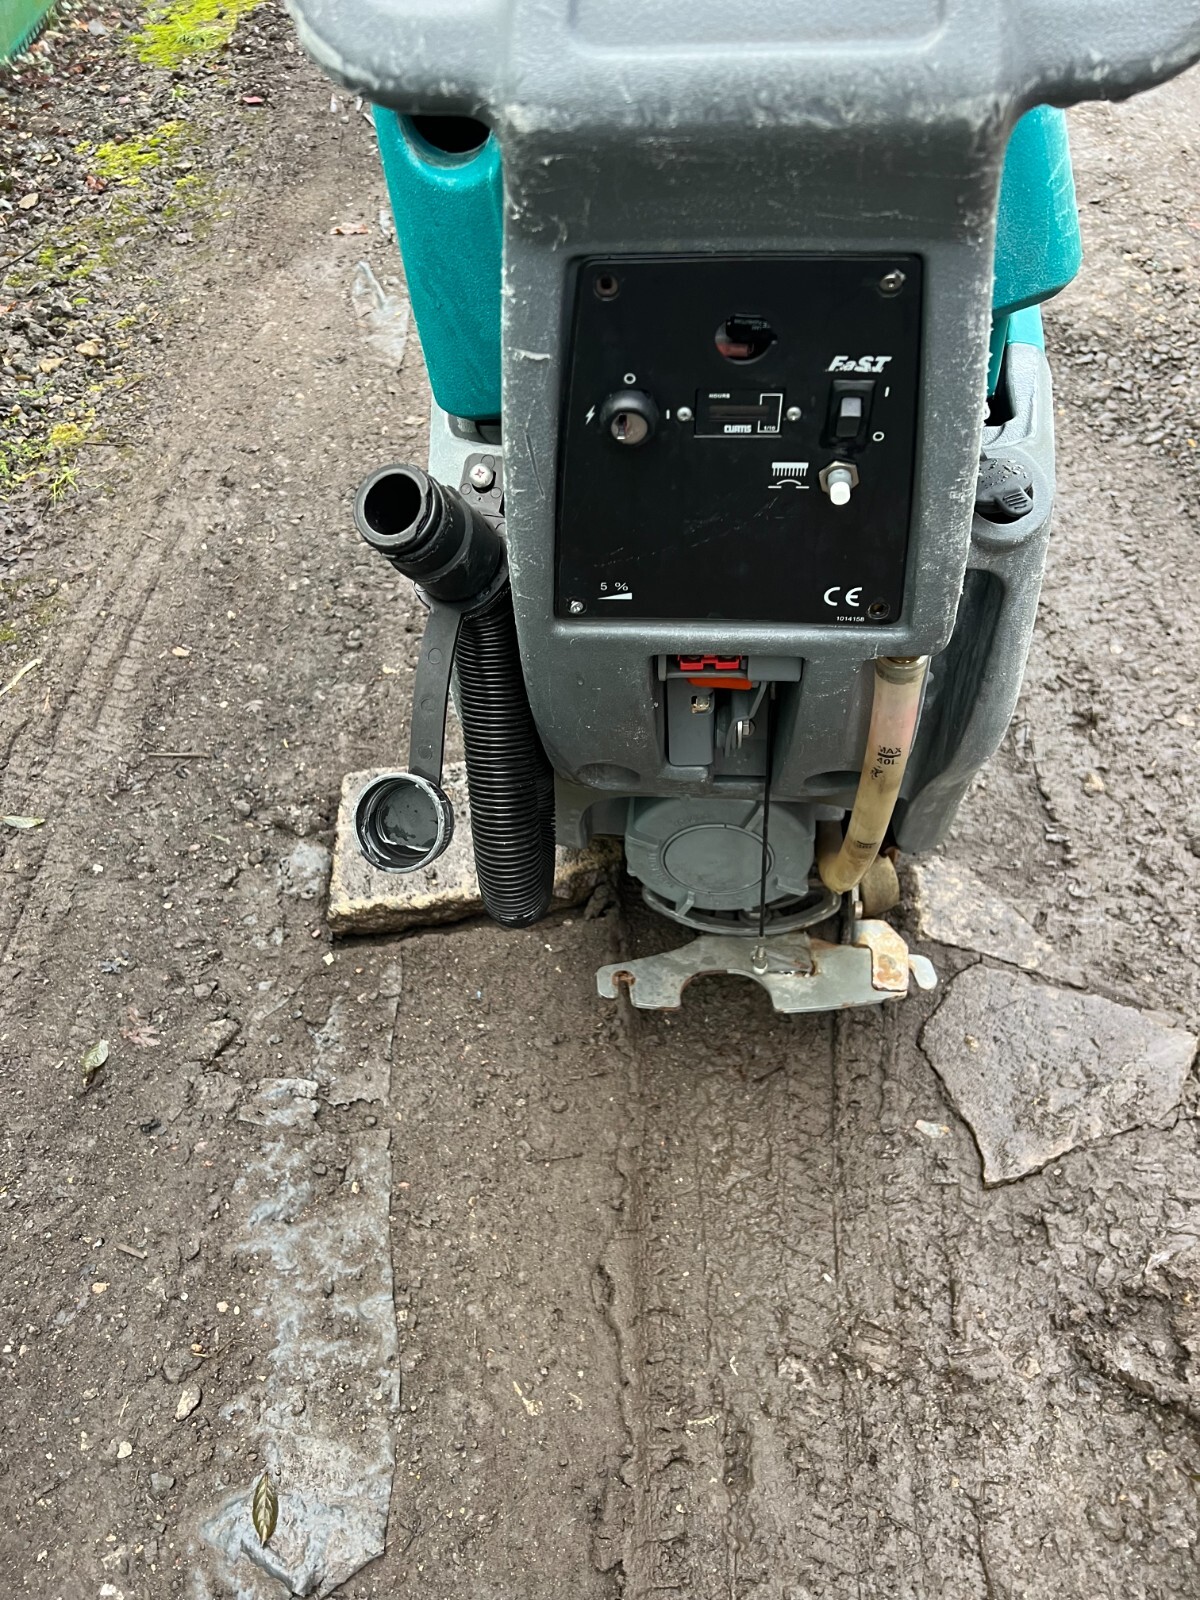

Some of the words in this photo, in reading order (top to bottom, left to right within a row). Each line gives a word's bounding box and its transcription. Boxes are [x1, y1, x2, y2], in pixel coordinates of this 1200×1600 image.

[724, 424, 753, 434] CURTIS
[600, 582, 608, 592] 5
[823, 586, 863, 607] CE
